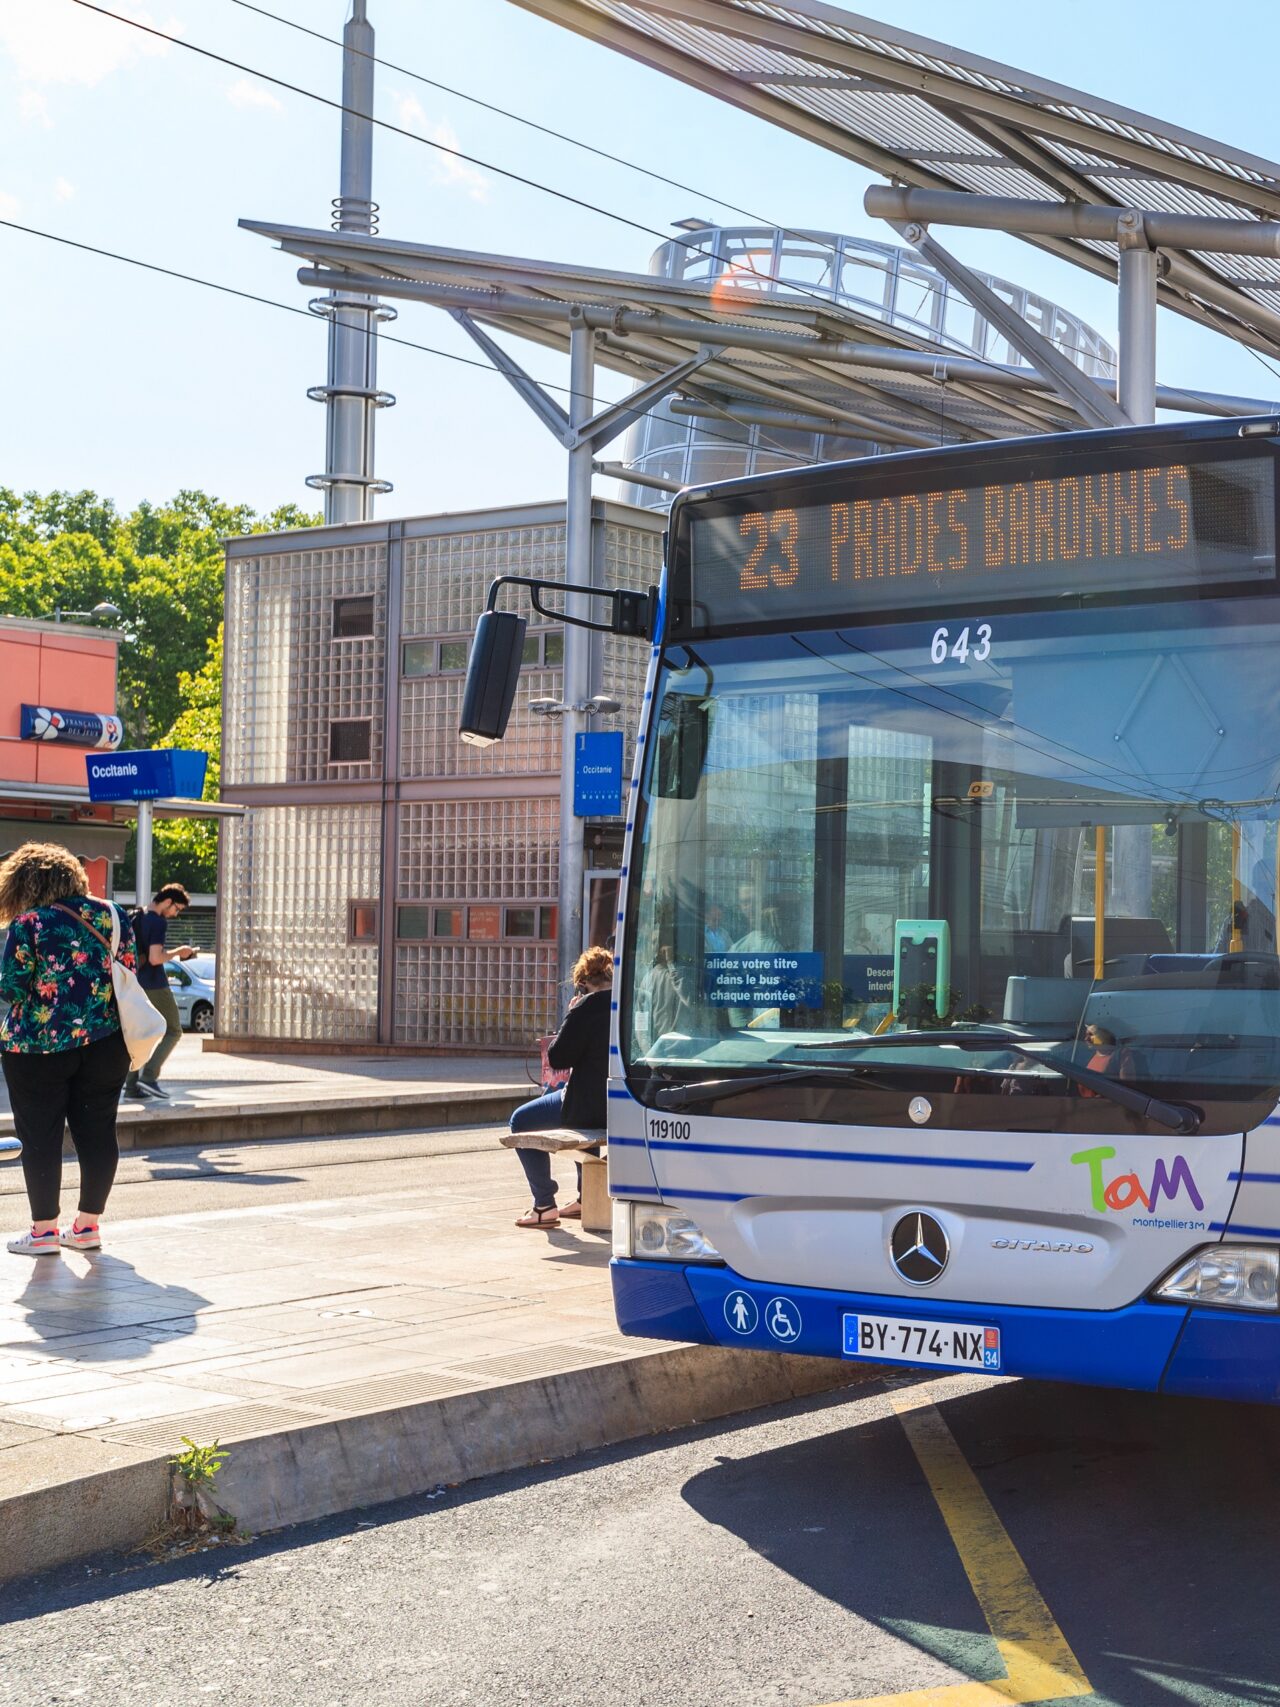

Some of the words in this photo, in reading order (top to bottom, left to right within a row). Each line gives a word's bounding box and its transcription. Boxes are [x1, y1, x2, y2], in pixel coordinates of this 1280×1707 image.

[739, 508, 799, 590] 23
[831, 489, 968, 582] PRADES
[984, 465, 1188, 568] BARONNES
[930, 624, 993, 665] 643
[580, 735, 586, 751] 1
[92, 763, 138, 778] Occitanie
[583, 765, 613, 774] Occitanie
[742, 959, 770, 969] votre
[773, 958, 798, 969] titre
[716, 975, 743, 985] dans
[746, 975, 757, 985] le
[759, 975, 780, 985] bus
[868, 982, 894, 991] interdi
[710, 990, 750, 1002] chaque
[753, 990, 796, 1001] montée
[650, 1119, 691, 1140] 119100
[1070, 1146, 1204, 1213] TaM
[991, 1237, 1094, 1254] CITARO
[848, 1336, 854, 1346] F
[985, 1350, 998, 1366] 34
